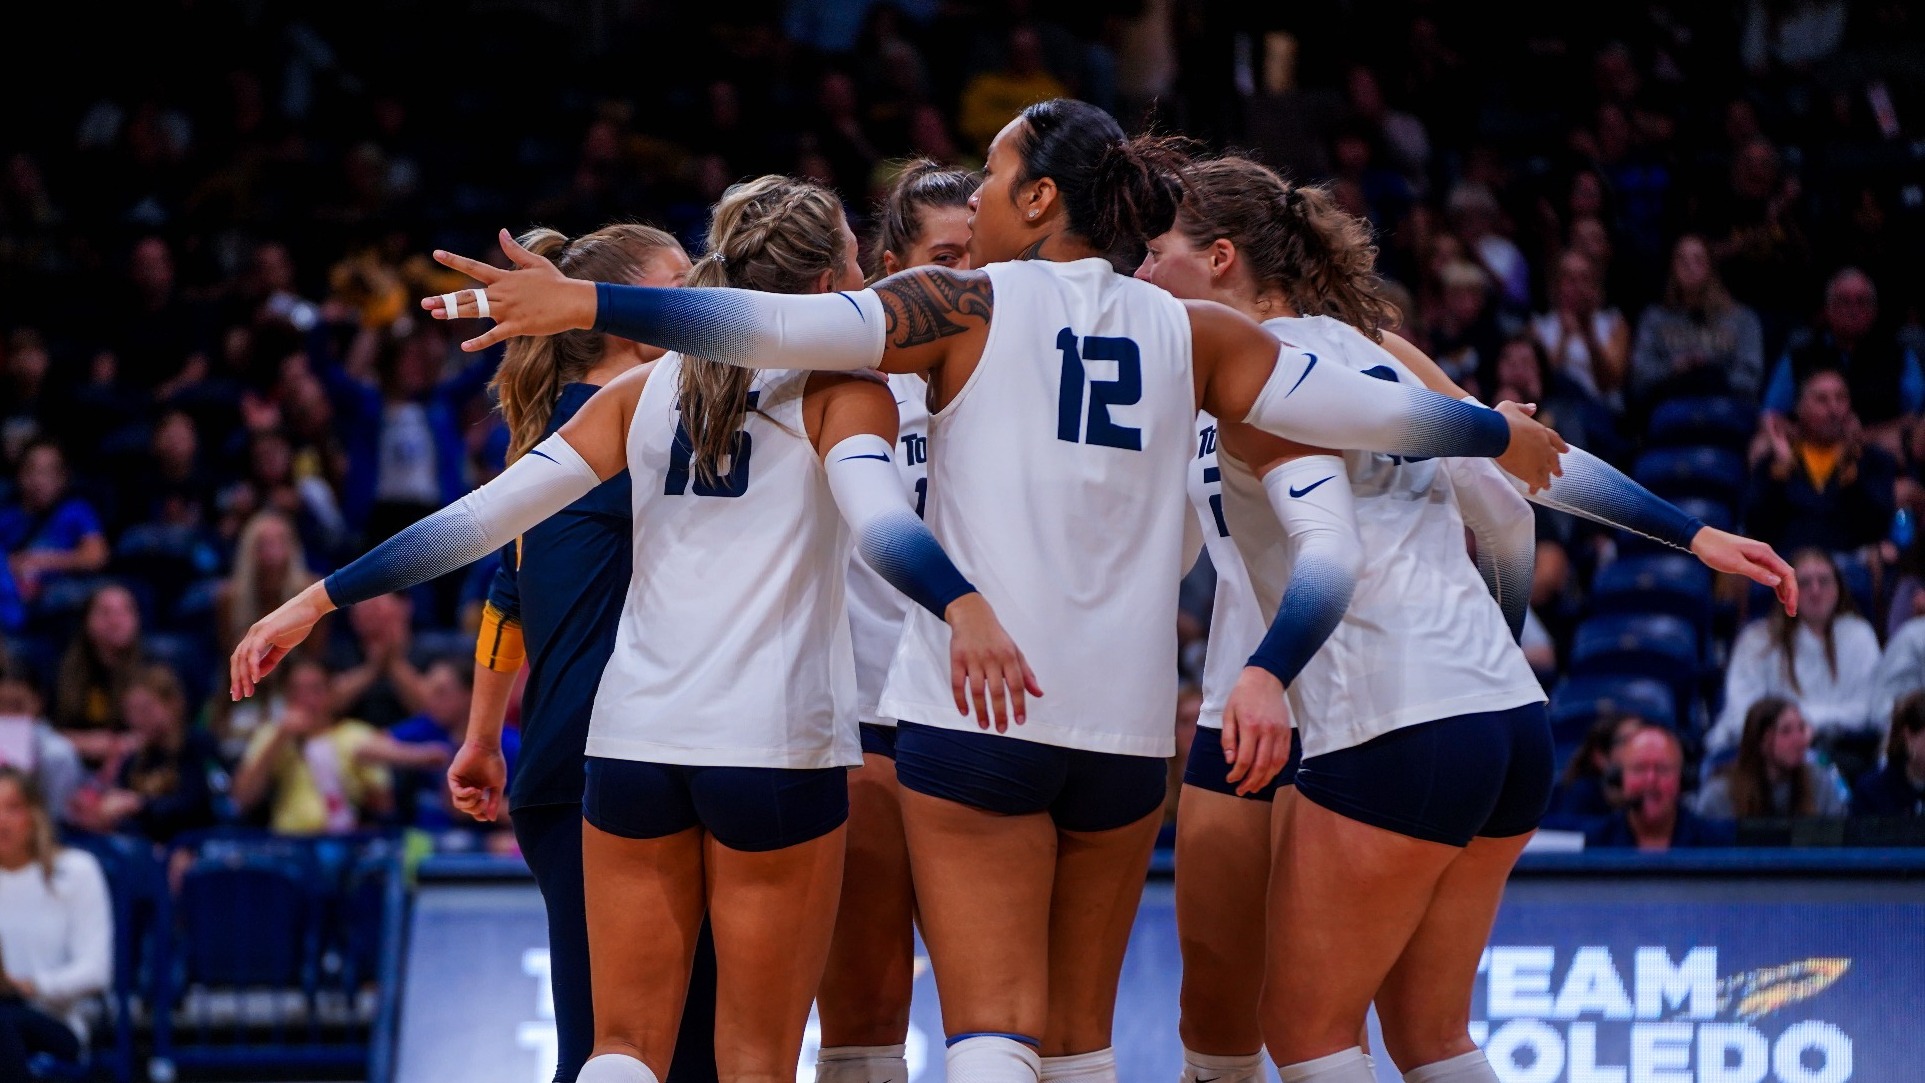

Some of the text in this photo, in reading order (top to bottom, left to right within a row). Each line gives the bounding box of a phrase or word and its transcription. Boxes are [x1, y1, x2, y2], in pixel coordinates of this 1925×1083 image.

[1056, 326, 1142, 452] 12
[1478, 945, 1718, 1021] EAM
[1468, 1018, 1853, 1083] OLEDO
